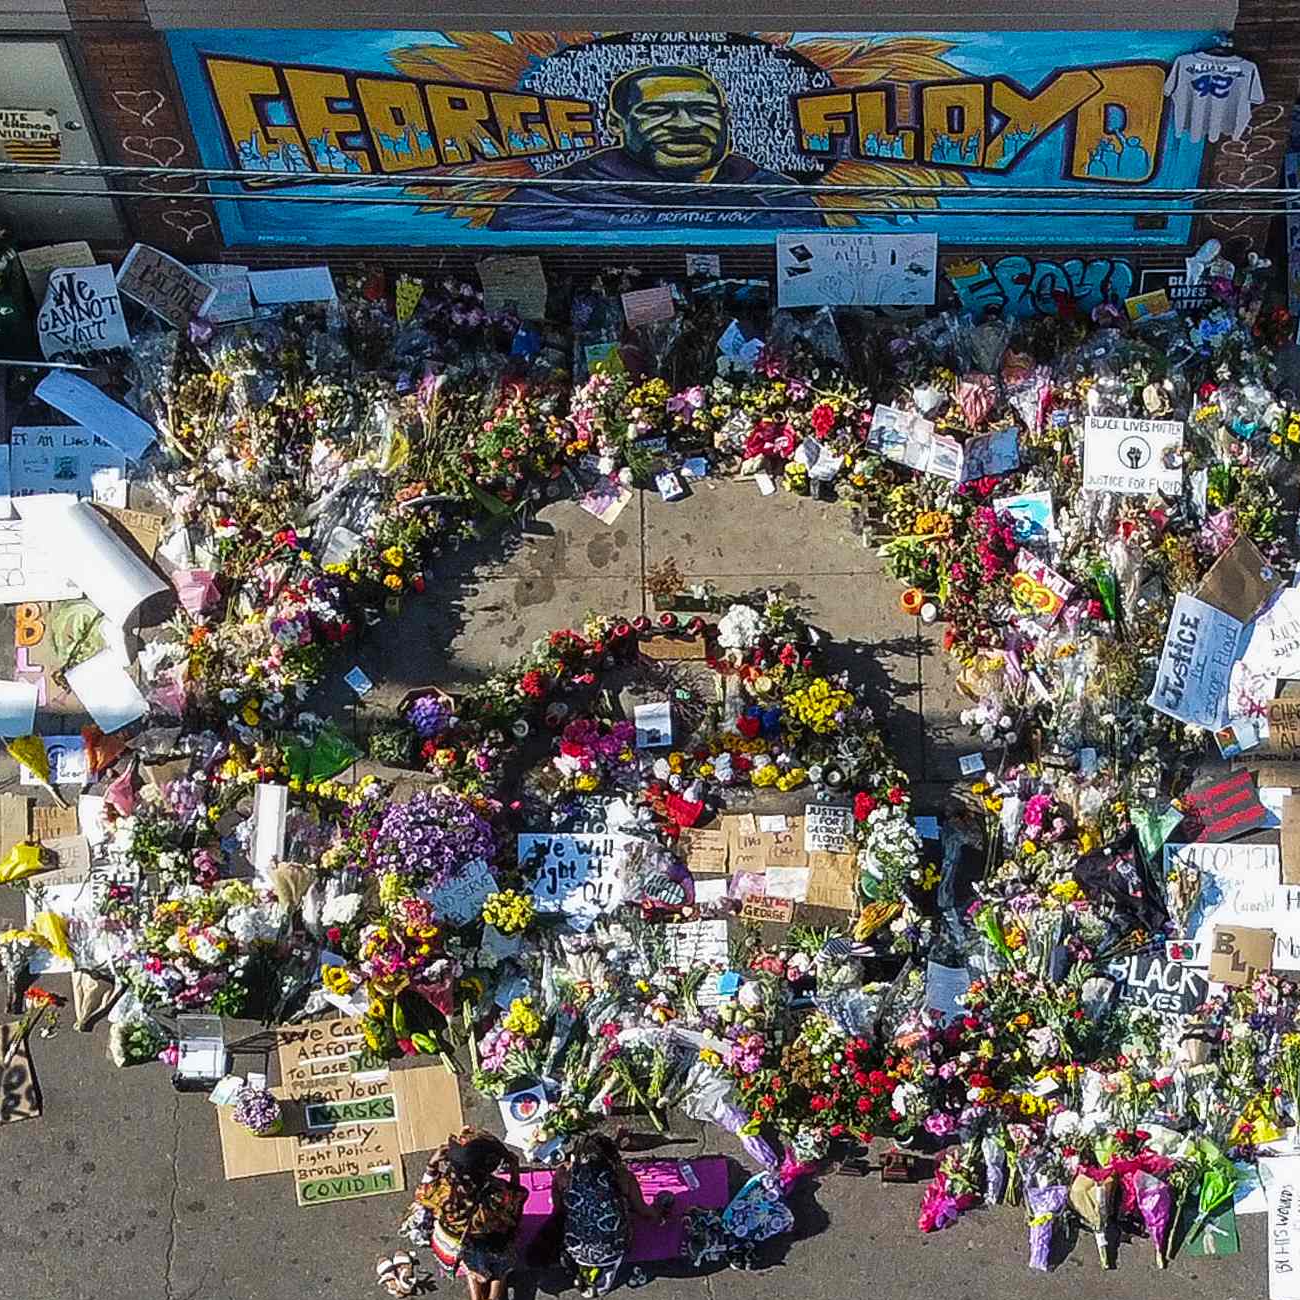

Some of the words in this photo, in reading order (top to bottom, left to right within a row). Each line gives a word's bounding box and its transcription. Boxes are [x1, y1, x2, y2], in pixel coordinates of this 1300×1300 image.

[631, 32, 657, 42] SAY
[659, 32, 686, 42] OUR
[203, 50, 600, 195] GEORGE
[797, 60, 1173, 188] FLOYD
[716, 210, 756, 224] NOW
[50, 273, 95, 307] We
[1170, 286, 1207, 297] LIVES
[49, 320, 107, 343] WAIT
[1089, 417, 1121, 432] BLACK
[1122, 420, 1151, 432] LIVES
[1085, 474, 1126, 489] JUSTICE
[1128, 476, 1148, 489] FOR
[530, 839, 569, 860] We
[574, 839, 614, 858] Will
[743, 904, 788, 922] GEORGE
[348, 1082, 388, 1099] Your
[302, 1177, 364, 1201] COVID
[372, 1176, 393, 1190] 19
